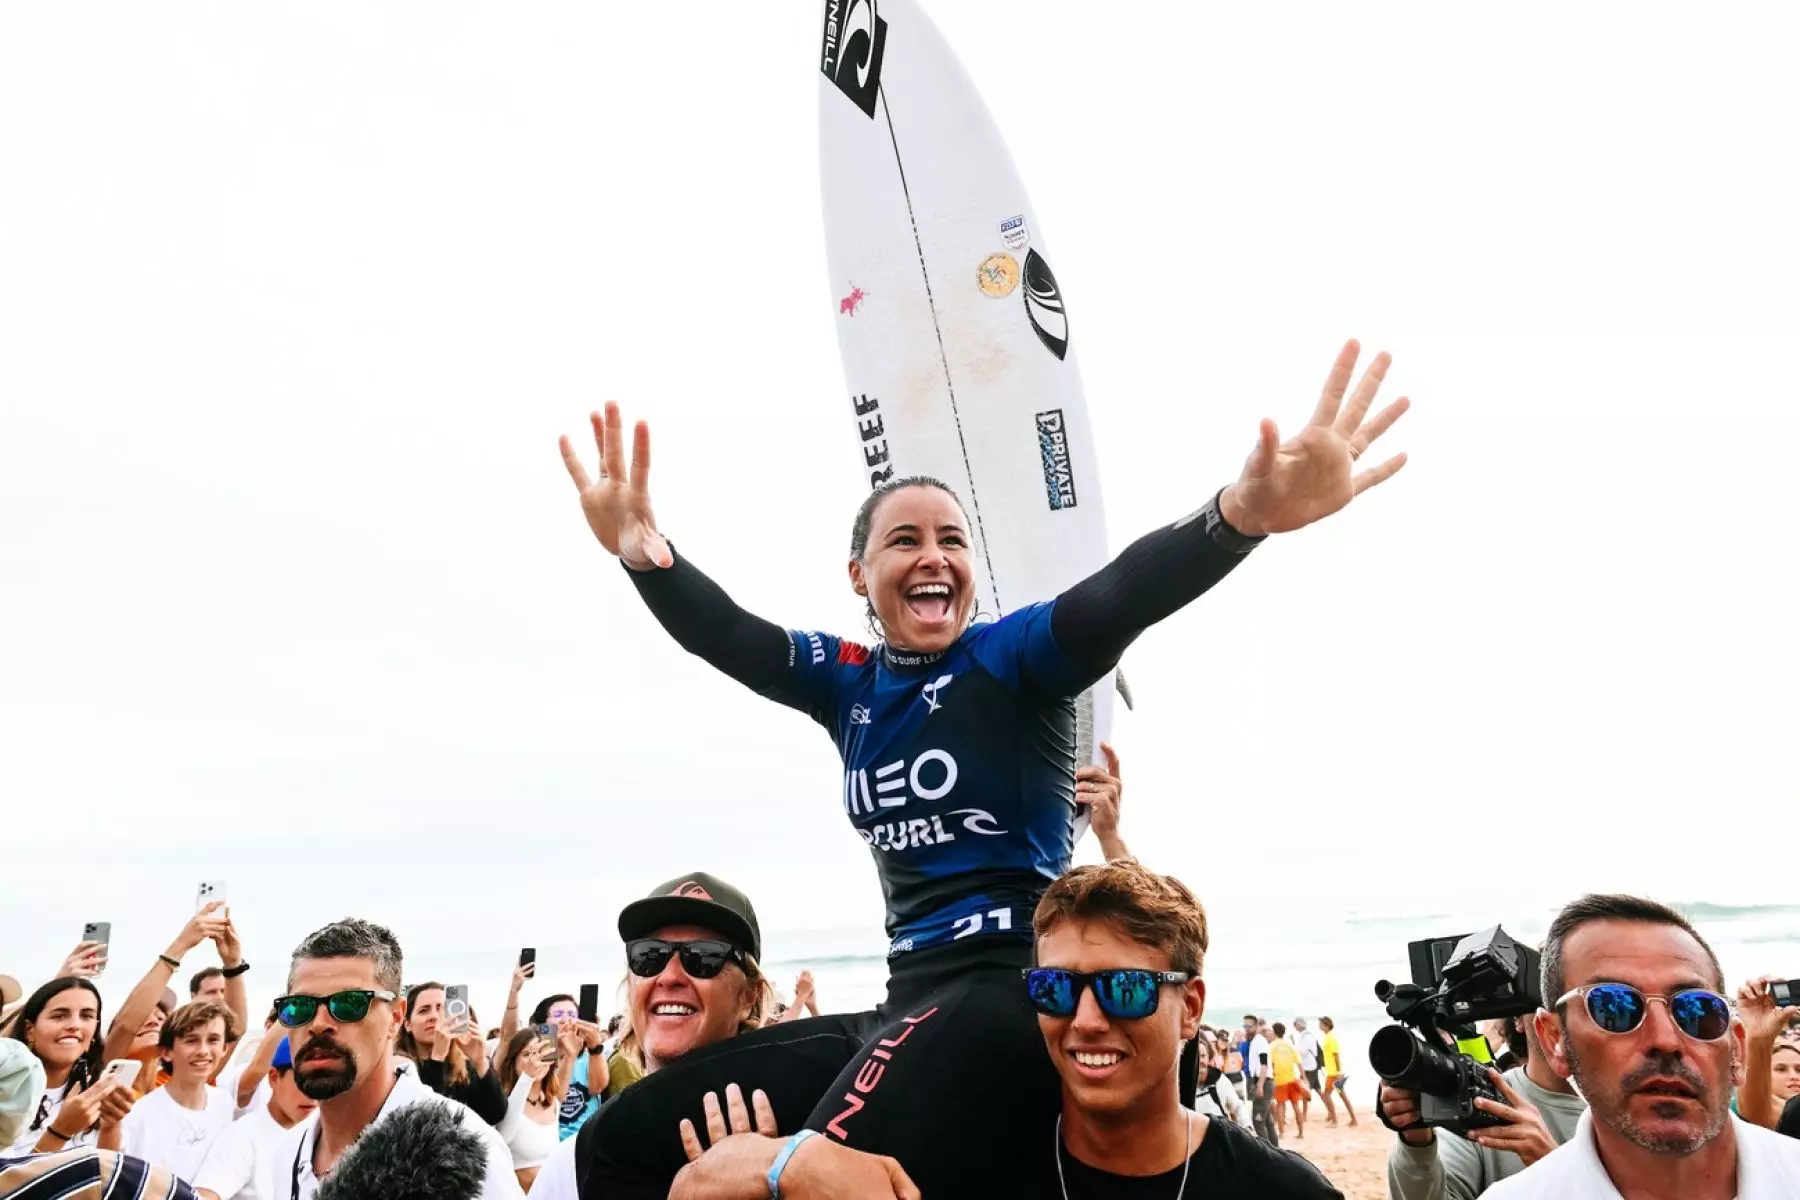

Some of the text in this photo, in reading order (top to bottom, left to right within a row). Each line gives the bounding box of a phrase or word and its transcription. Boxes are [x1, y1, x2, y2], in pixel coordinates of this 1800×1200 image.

[824, 0, 840, 71] NEILL
[1050, 431, 1074, 508] PRIVATE
[898, 655, 921, 666] SURF
[951, 907, 1012, 941] 21
[826, 1007, 939, 1140] NEILL
